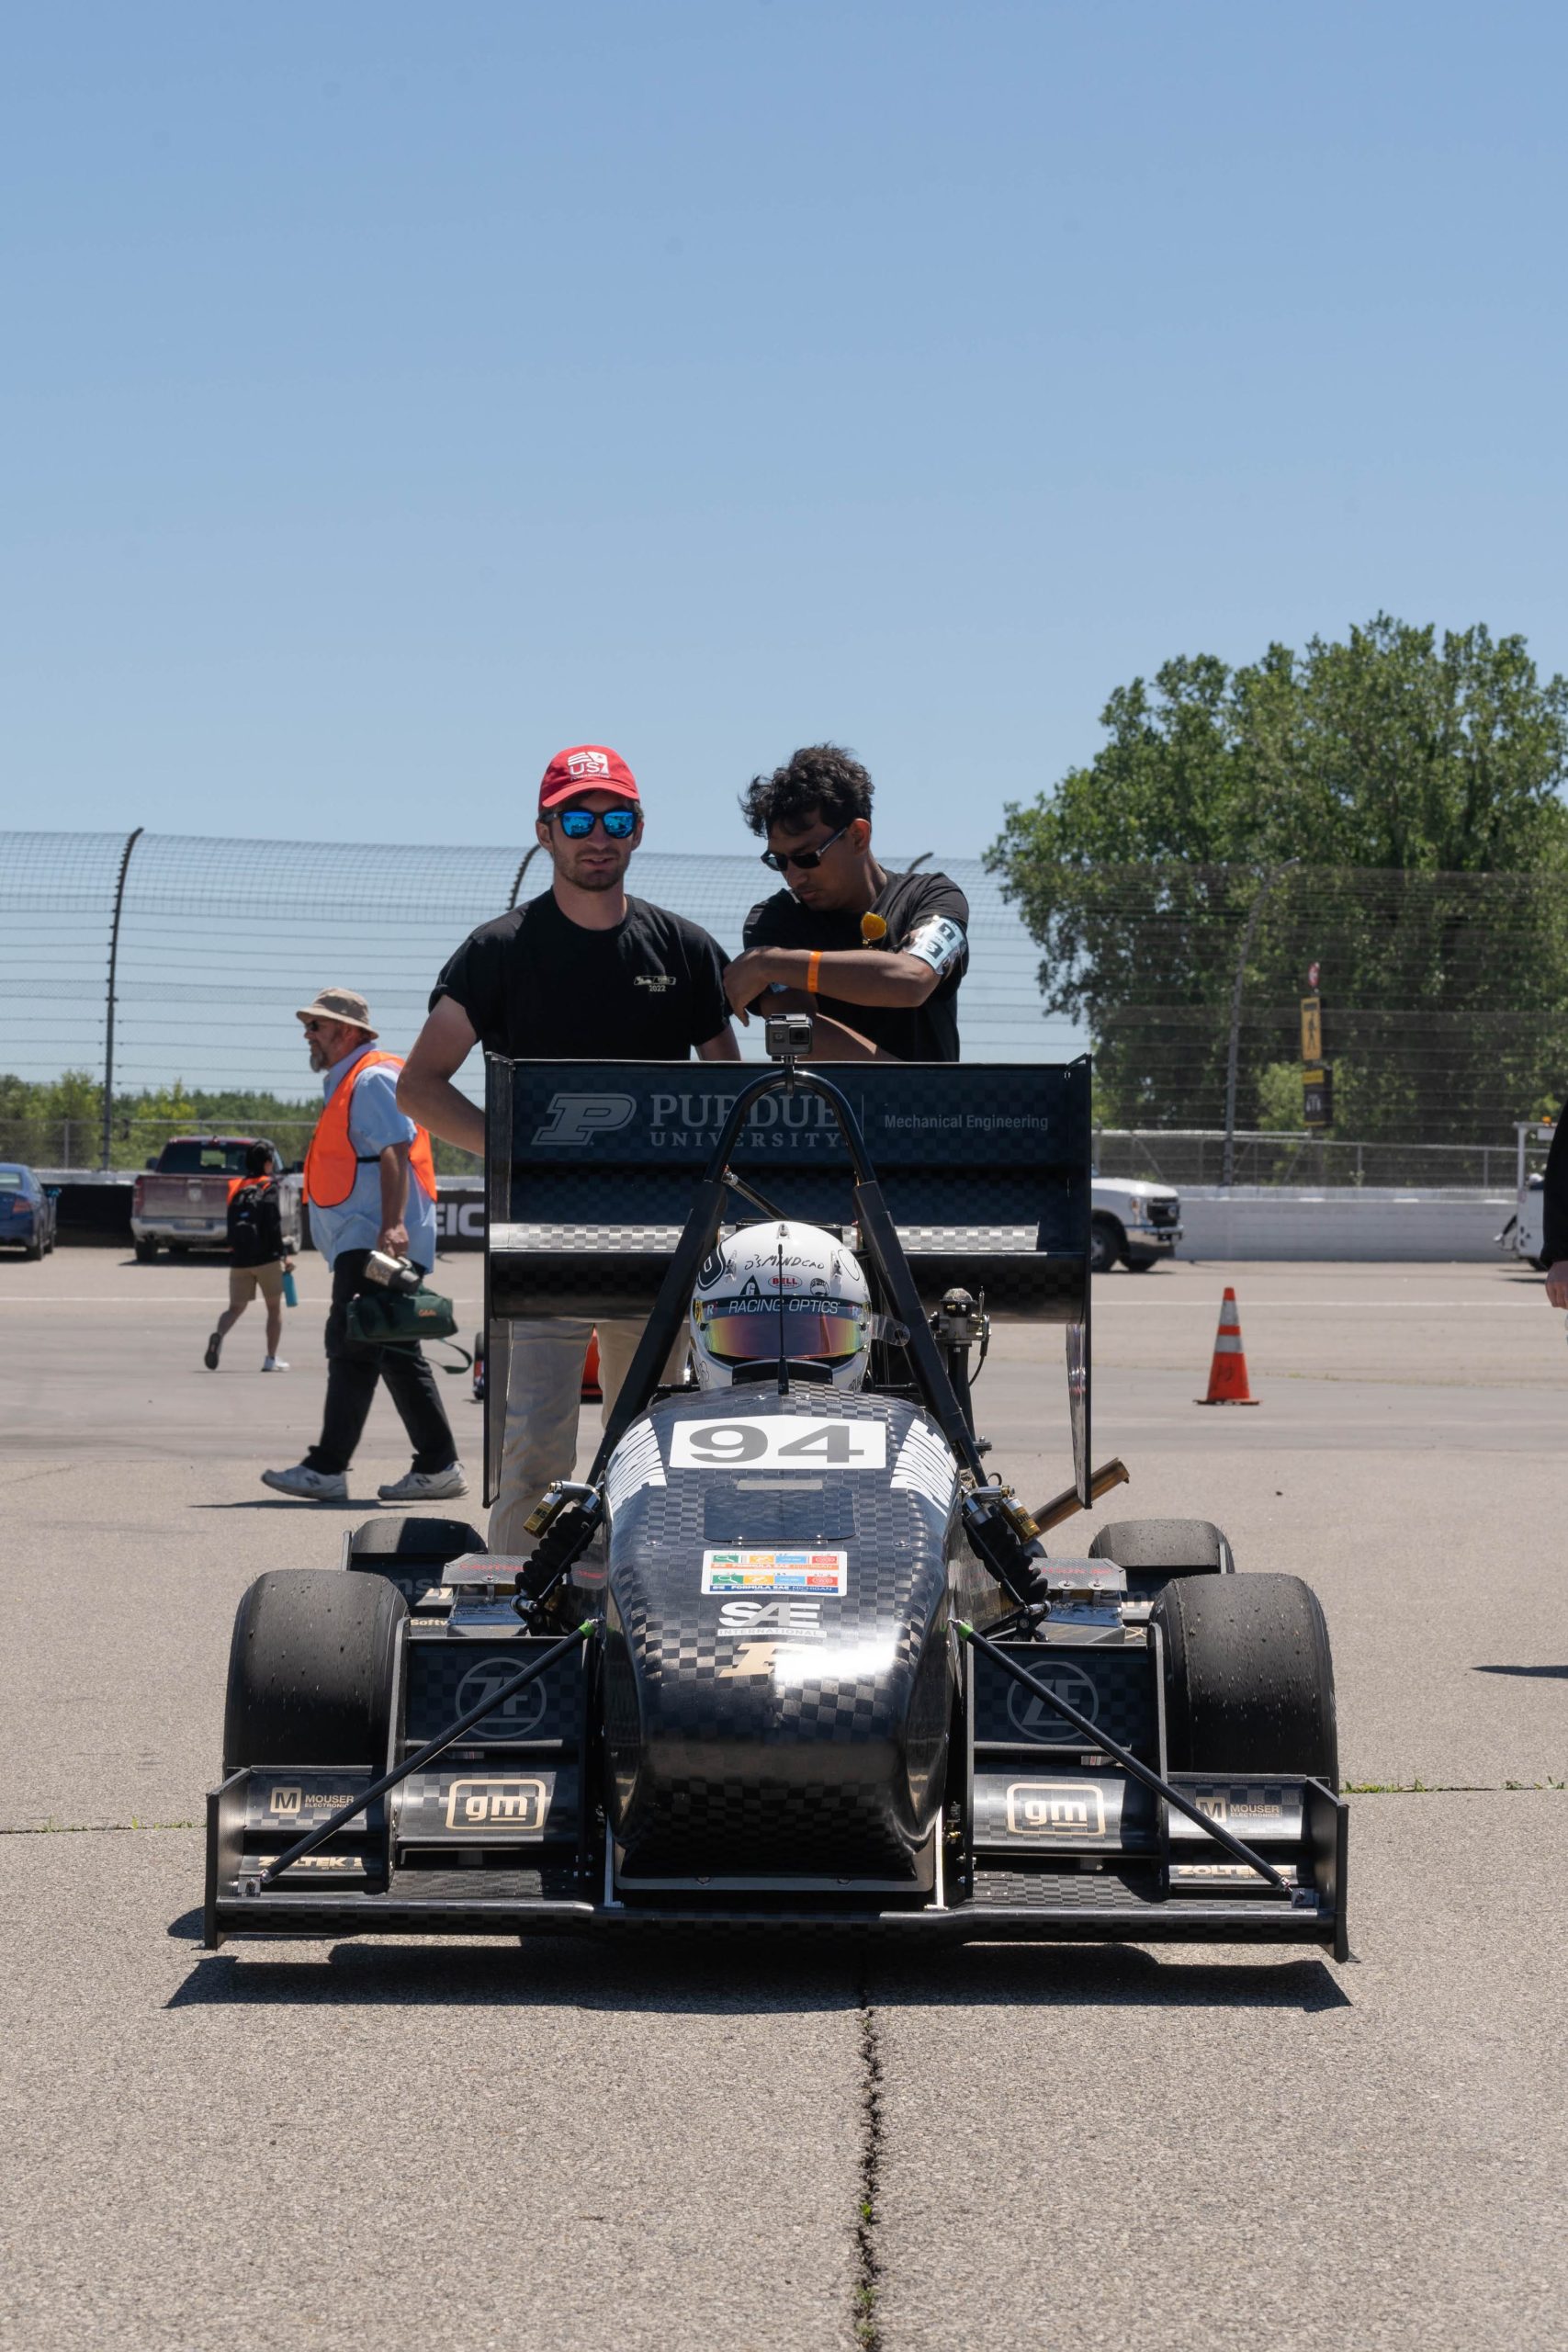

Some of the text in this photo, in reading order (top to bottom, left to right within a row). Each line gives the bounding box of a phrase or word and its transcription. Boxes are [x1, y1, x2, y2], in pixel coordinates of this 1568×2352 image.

[885, 1114, 1049, 1131] Mechanical Engineering
[728, 1299, 838, 1314] RACING OPTICS
[689, 1424, 865, 1464] 94
[718, 1601, 820, 1629] SAE
[719, 1628, 818, 1636] INTERNATIONAL
[305, 1795, 355, 1804] MOUSER
[466, 1796, 528, 1821] gm
[1024, 1801, 1088, 1827] gm
[1230, 1804, 1280, 1814] MOUSER
[258, 1856, 347, 1867] ZLTEK
